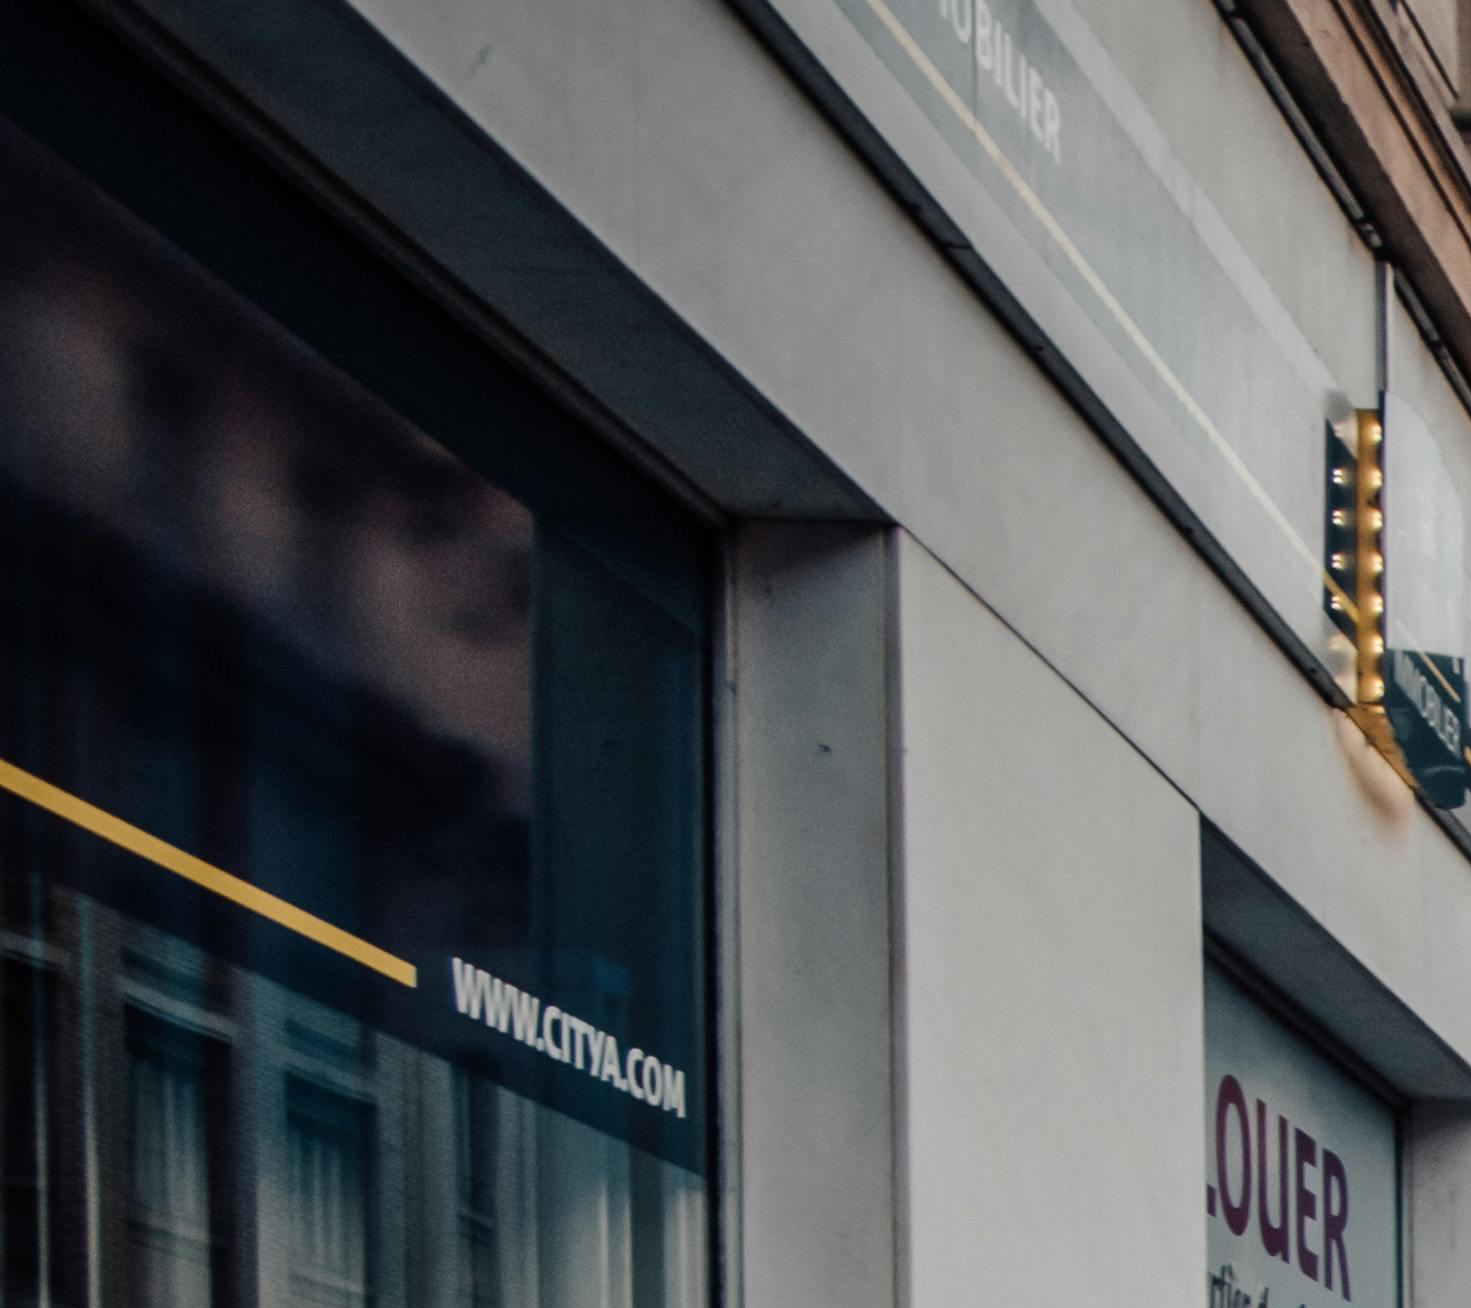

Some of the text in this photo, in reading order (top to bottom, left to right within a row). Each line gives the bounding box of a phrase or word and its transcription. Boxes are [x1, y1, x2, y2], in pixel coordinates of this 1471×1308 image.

[938, 0, 1062, 166] OBILIER
[452, 956, 687, 1119] WWW.CITYA.COM
[1206, 1074, 1351, 1302] OUER
